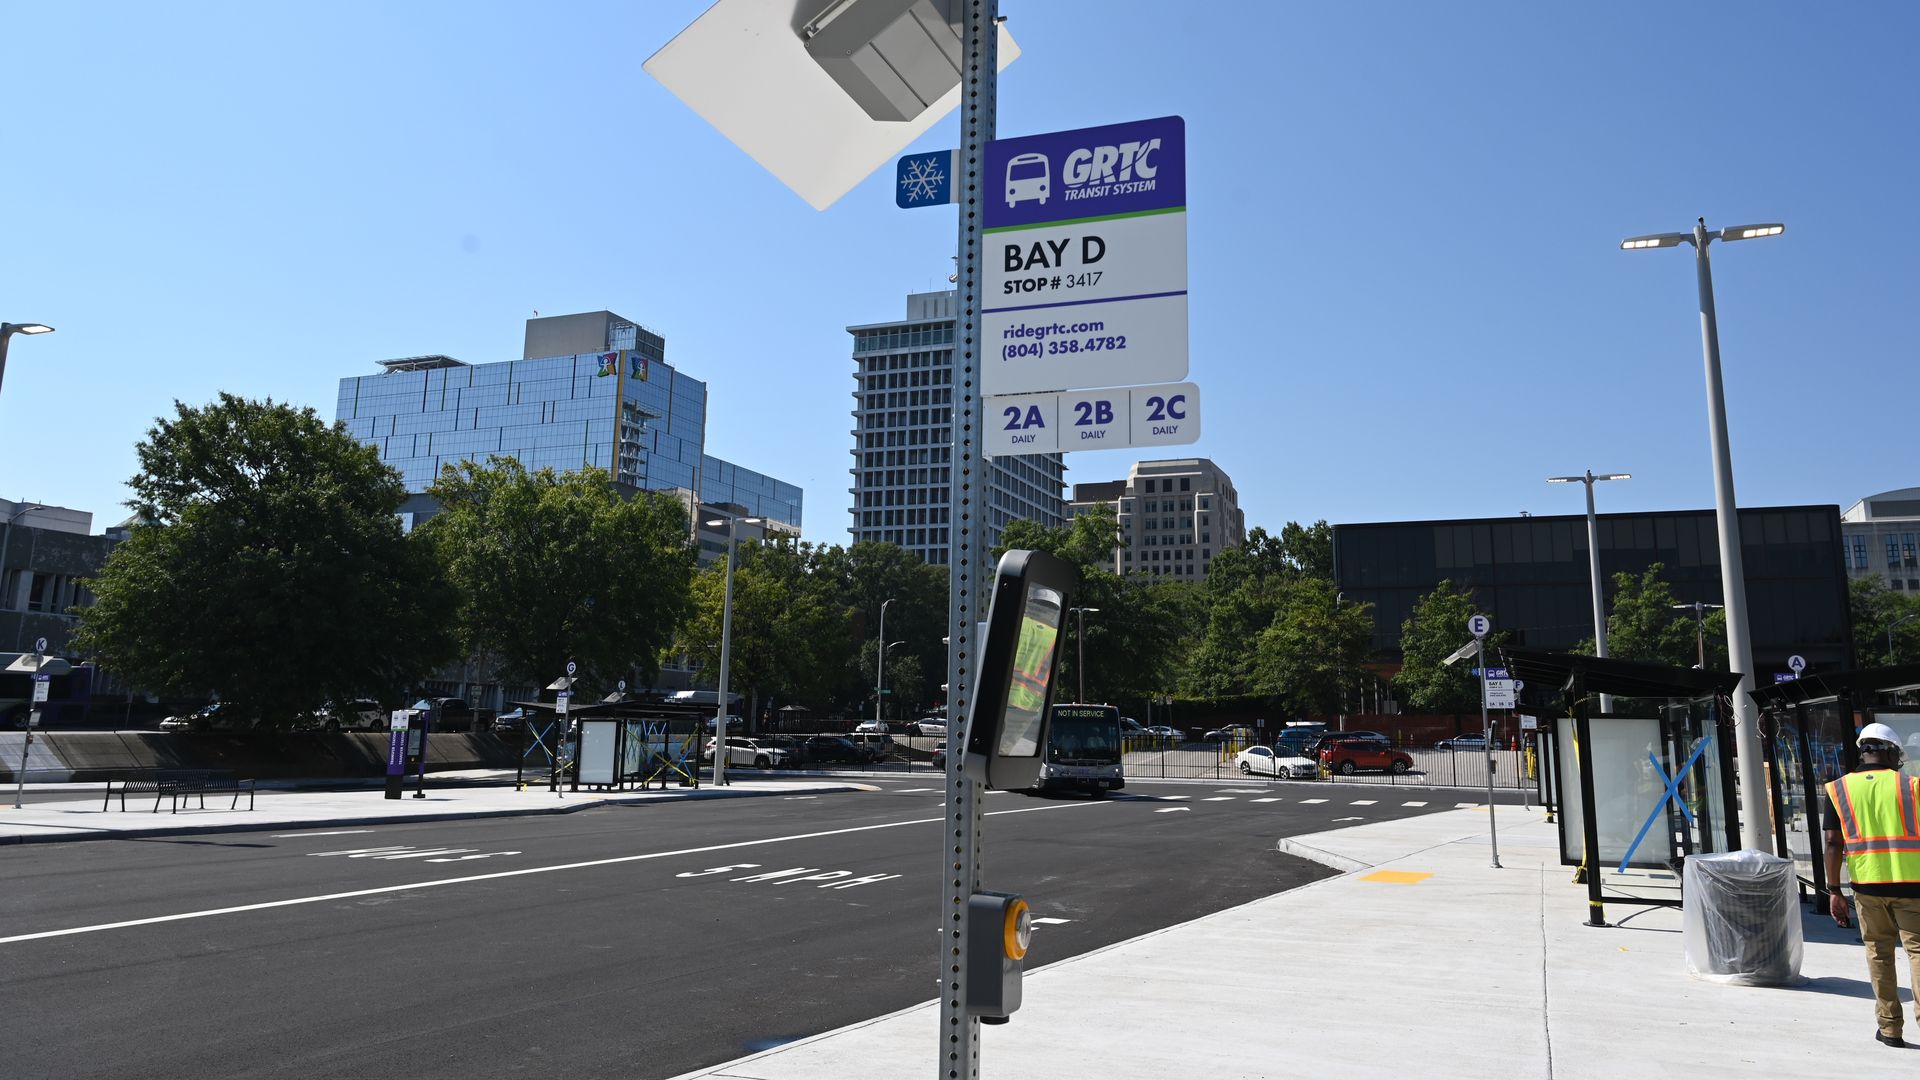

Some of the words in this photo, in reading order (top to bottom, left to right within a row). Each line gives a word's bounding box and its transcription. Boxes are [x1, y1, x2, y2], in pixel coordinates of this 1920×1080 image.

[1063, 138, 1161, 188] GRTC
[1065, 185, 1111, 201] TRANSIT
[1112, 180, 1156, 195] SYSTEM
[1005, 238, 1070, 272] BAY
[1082, 236, 1106, 264] D
[1066, 271, 1103, 288] 3417
[1003, 321, 1104, 340] ridegrtc.com
[1002, 342, 1043, 361] (804)
[1048, 335, 1126, 355] 358.4782
[1003, 405, 1045, 430] 2A
[1074, 400, 1114, 426] 2B
[1145, 394, 1186, 421] 2C
[1011, 434, 1036, 443] DAILY
[1081, 430, 1106, 440] DAILY
[1152, 426, 1178, 435] DAILY
[1474, 618, 1484, 632] E
[38, 640, 45, 650] K
[1792, 657, 1803, 668] A
[675, 863, 762, 877] 5
[729, 867, 903, 889] MPH
